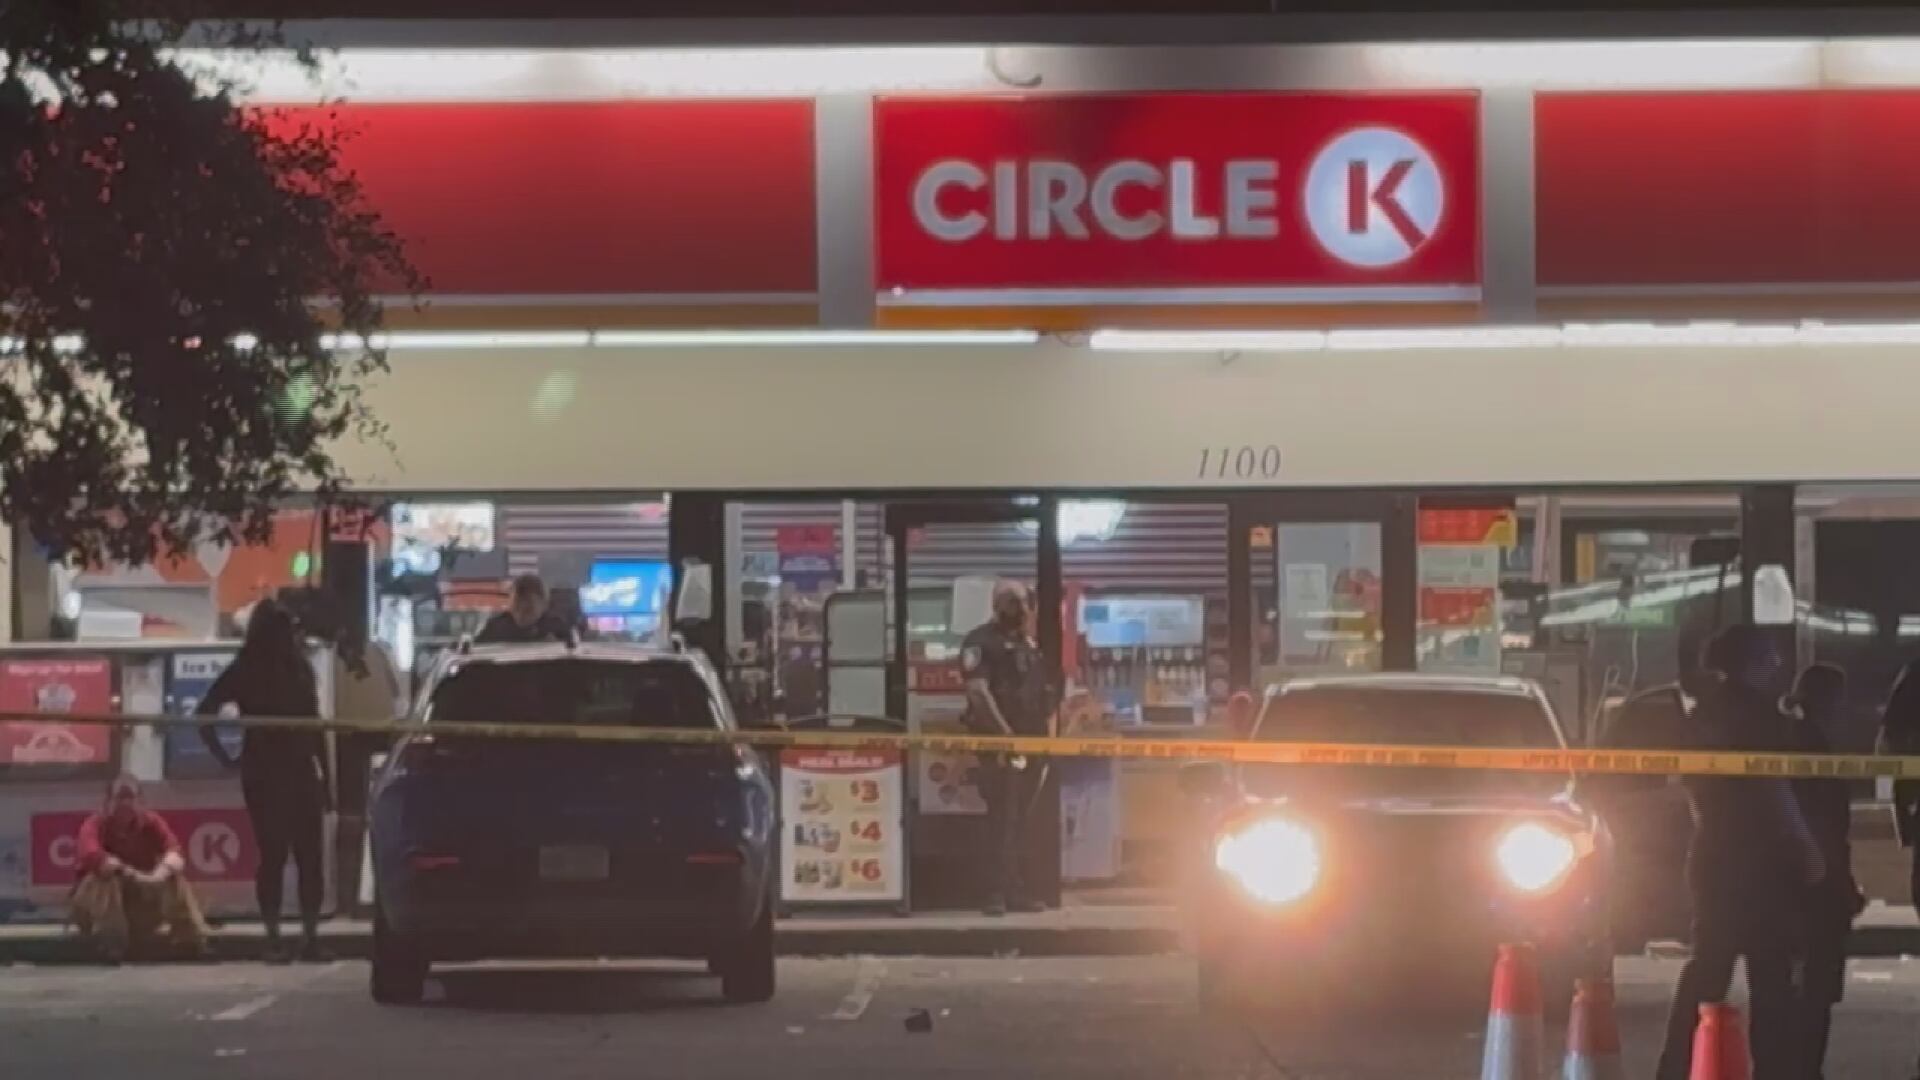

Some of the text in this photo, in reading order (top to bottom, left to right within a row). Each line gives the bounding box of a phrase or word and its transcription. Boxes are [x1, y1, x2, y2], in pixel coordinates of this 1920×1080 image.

[912, 157, 1429, 252] CIRCLE K
[1198, 444, 1281, 479] 1100
[850, 779, 880, 804] $3
[850, 820, 882, 842] $4
[202, 833, 240, 872] K
[851, 858, 882, 882] $6
